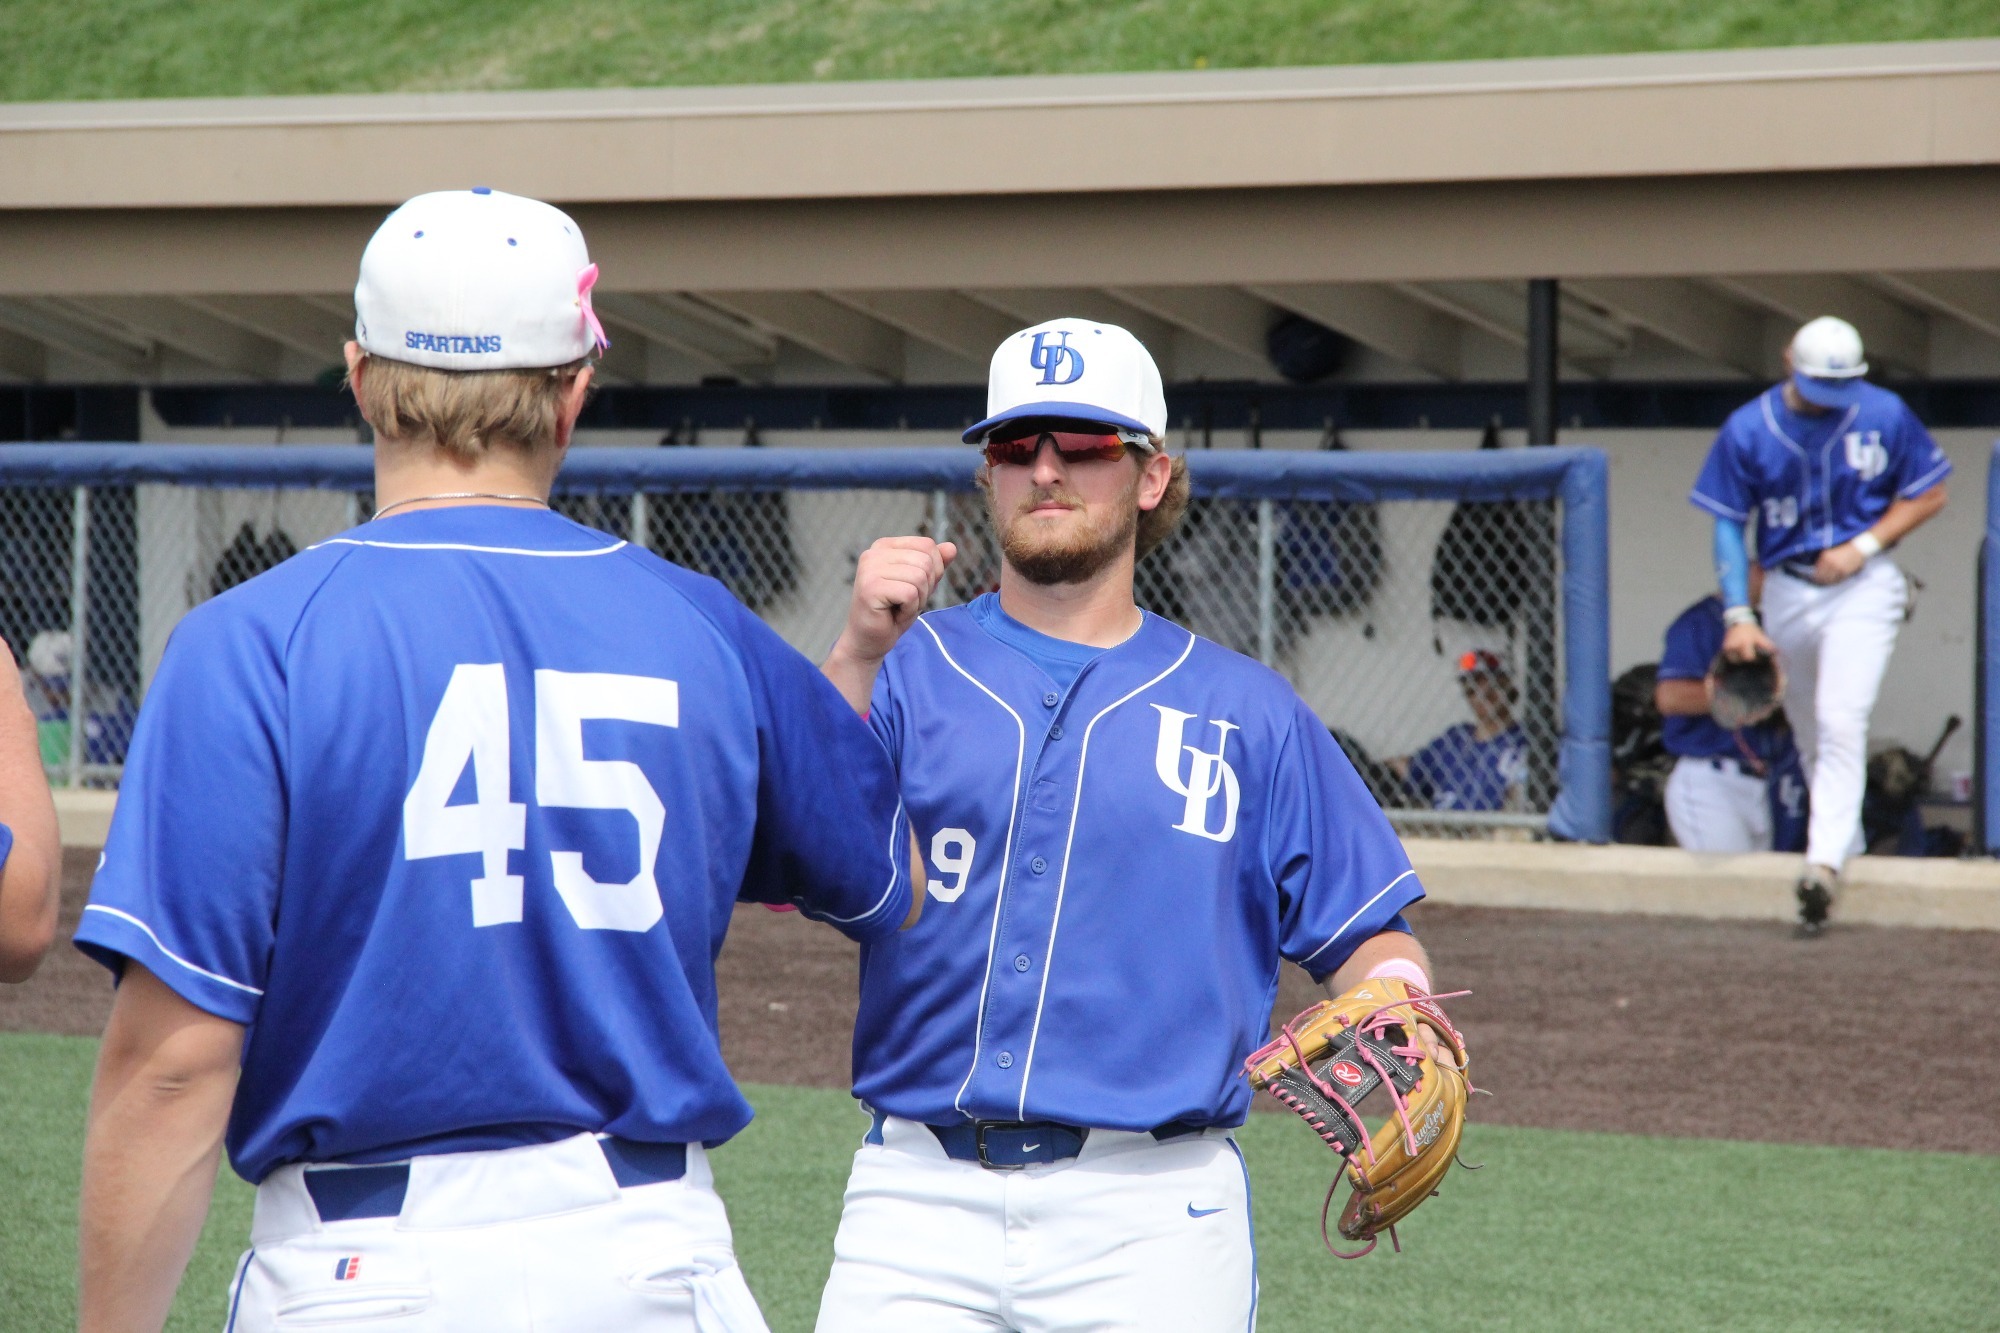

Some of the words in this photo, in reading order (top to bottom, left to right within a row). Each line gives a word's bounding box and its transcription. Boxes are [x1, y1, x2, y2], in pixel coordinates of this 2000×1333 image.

[405, 330, 502, 354] SPARTANS
[403, 662, 679, 933] 45
[1149, 702, 1241, 843] UD
[927, 827, 977, 903] 9
